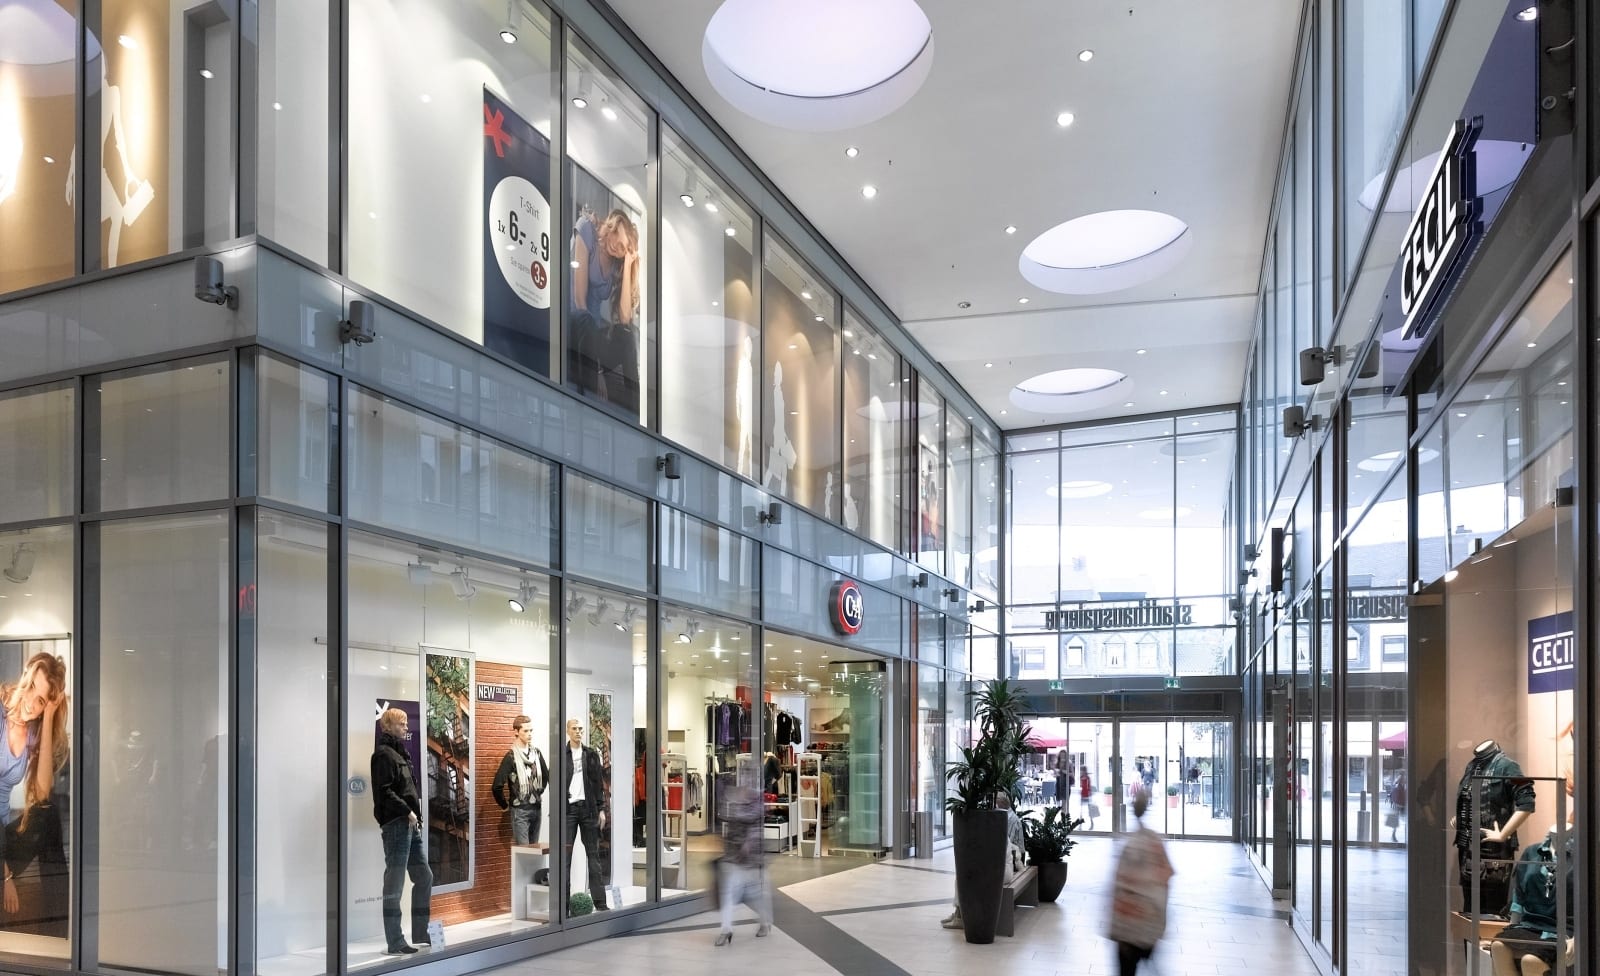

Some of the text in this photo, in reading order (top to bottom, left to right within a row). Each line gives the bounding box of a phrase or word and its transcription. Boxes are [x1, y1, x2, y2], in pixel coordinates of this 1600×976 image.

[519, 196, 541, 221] T-Shirt
[497, 219, 506, 234] 1x
[1400, 155, 1457, 316] CECIL
[530, 241, 538, 255] 2x
[478, 685, 496, 700] NEW
